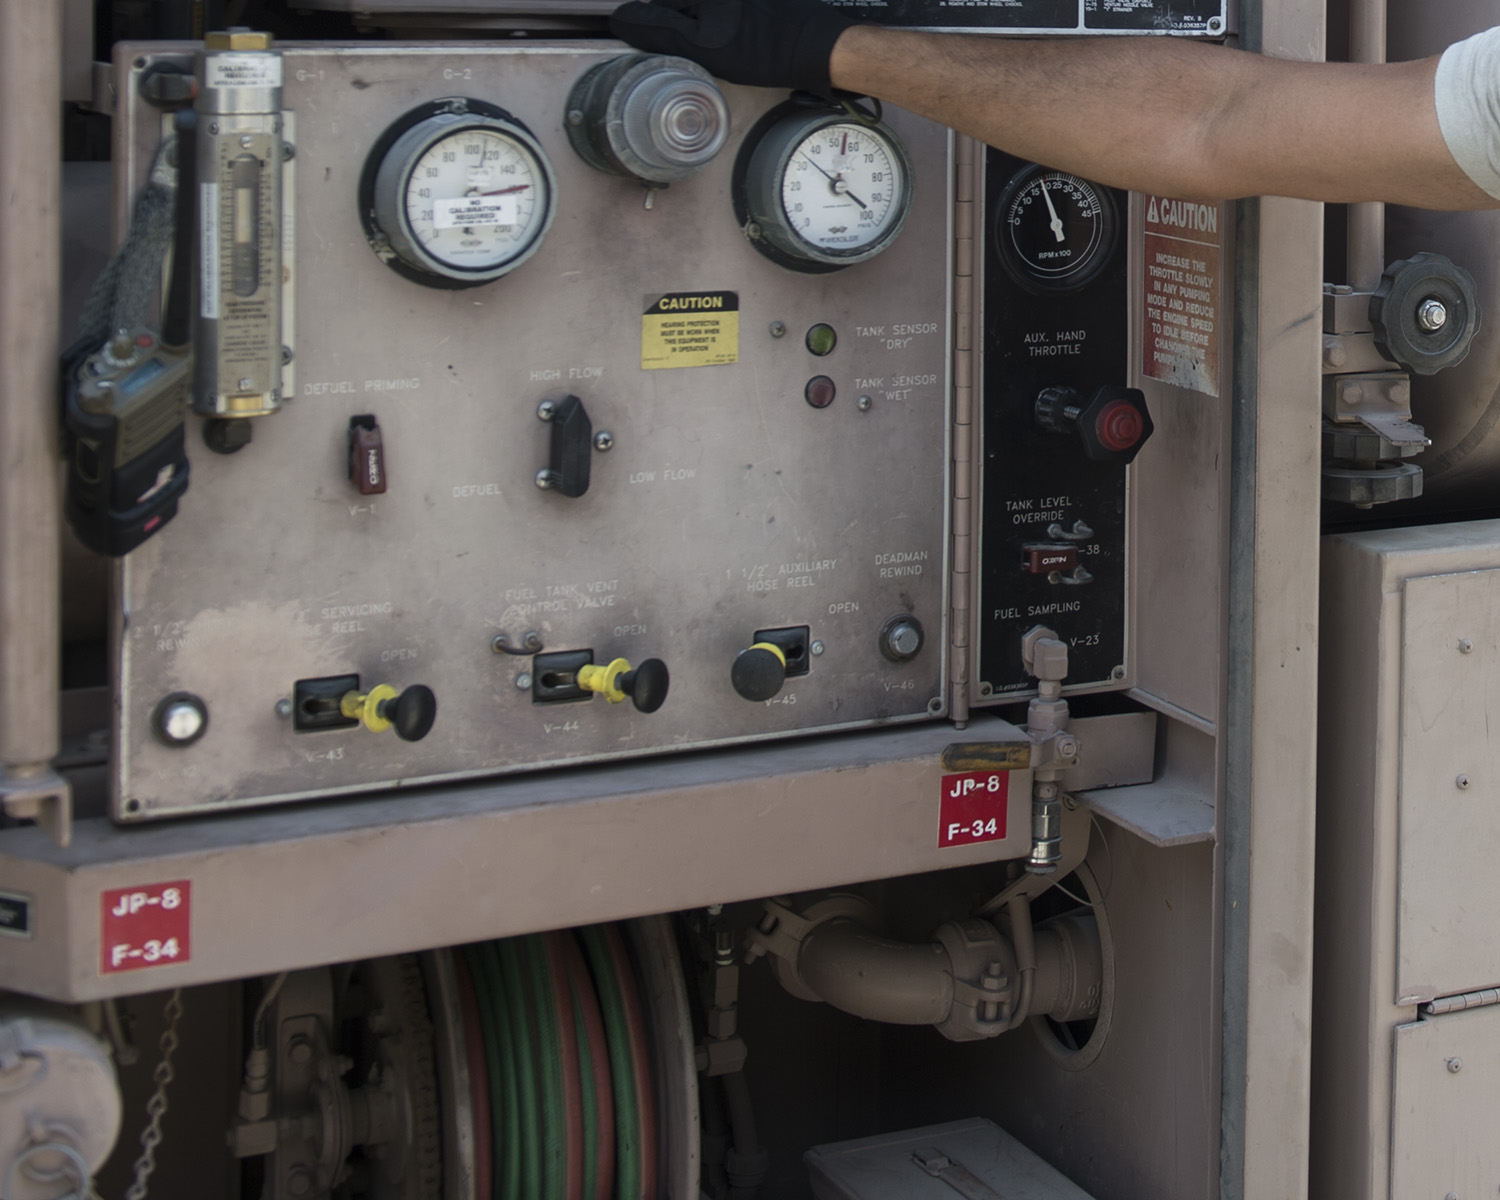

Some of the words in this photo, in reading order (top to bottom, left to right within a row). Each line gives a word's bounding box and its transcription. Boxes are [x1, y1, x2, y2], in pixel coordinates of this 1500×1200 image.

[443, 68, 473, 80] G-2
[829, 138, 840, 147] 50
[848, 142, 859, 152] 60
[810, 145, 821, 155] 40
[864, 154, 875, 163] 70
[796, 161, 808, 171] 30
[872, 172, 883, 182] 80
[417, 188, 430, 198] 40
[790, 181, 801, 191] 20
[1031, 187, 1041, 196] 15
[1052, 182, 1063, 190] 25
[1063, 184, 1075, 193] 30
[871, 193, 882, 203] 90
[1023, 197, 1032, 205] 10
[1071, 189, 1082, 200] 35
[449, 205, 501, 214] CALIBRATION
[794, 202, 803, 213] 10
[1018, 207, 1024, 215] 5
[1077, 200, 1089, 208] 40
[860, 211, 873, 221] 100
[1014, 216, 1021, 225] 0
[1081, 210, 1092, 218] 45
[1160, 198, 1217, 233] CAUTION
[1155, 252, 1190, 270] INCREASE
[1192, 260, 1206, 273] THE
[1149, 266, 1183, 283] THROTTLE
[1185, 273, 1213, 288] SLOWLY
[1154, 280, 1161, 292] IN
[1163, 282, 1177, 295] ANY
[1179, 286, 1210, 303] PUMPING
[659, 296, 723, 310] CAUTION
[1147, 293, 1167, 307] MODE
[1169, 298, 1183, 311] AND
[1185, 302, 1214, 319] REDUCE
[1148, 307, 1161, 320] THE
[1163, 310, 1188, 327] ENGINE
[1190, 315, 1213, 332] SPEED
[856, 325, 886, 337] TANK
[893, 323, 938, 335] SENSOR
[1024, 332, 1049, 343] AUX.
[1056, 330, 1086, 341] HAND
[1152, 322, 1161, 334] TO
[1163, 323, 1179, 338] IDLE
[1181, 328, 1209, 346] BEFORE
[1029, 344, 1081, 356] THROTTLE
[529, 369, 560, 382] HIGH
[569, 366, 604, 380] FLOW
[304, 382, 357, 397] DEFUEL
[364, 378, 421, 394] PRIMING
[855, 377, 885, 389] TANK
[892, 374, 937, 387] SENSOR
[629, 470, 657, 484] LOW
[664, 468, 697, 482] FLOW
[453, 484, 503, 498] DEFUEL
[1006, 500, 1033, 511] TANK
[1040, 496, 1073, 509] LEVEL
[1013, 510, 1064, 524] OVERRIDE
[875, 550, 928, 566] DEADMAN
[779, 559, 838, 576] AUXILIARY
[880, 564, 922, 579] REWIND
[545, 584, 578, 598] TANK
[587, 579, 619, 593] VENT
[747, 579, 778, 593] HOSE
[788, 575, 815, 588] REEL
[576, 595, 616, 609] VALVE
[828, 601, 860, 615] OPEN
[321, 602, 393, 620] SERVICING
[994, 608, 1021, 620] FUEL
[1028, 601, 1080, 616] SAMPLING
[332, 620, 365, 634] REEL
[614, 625, 648, 638] OPEN
[1070, 635, 1100, 647] V-23
[382, 648, 418, 662] OPEN
[884, 680, 914, 692] V-46
[765, 693, 797, 707] V-45
[543, 721, 579, 735] V-44
[950, 776, 1000, 799] JP-8
[948, 820, 998, 840] F-34
[112, 888, 181, 917] JP-8
[112, 939, 179, 967] F-34
